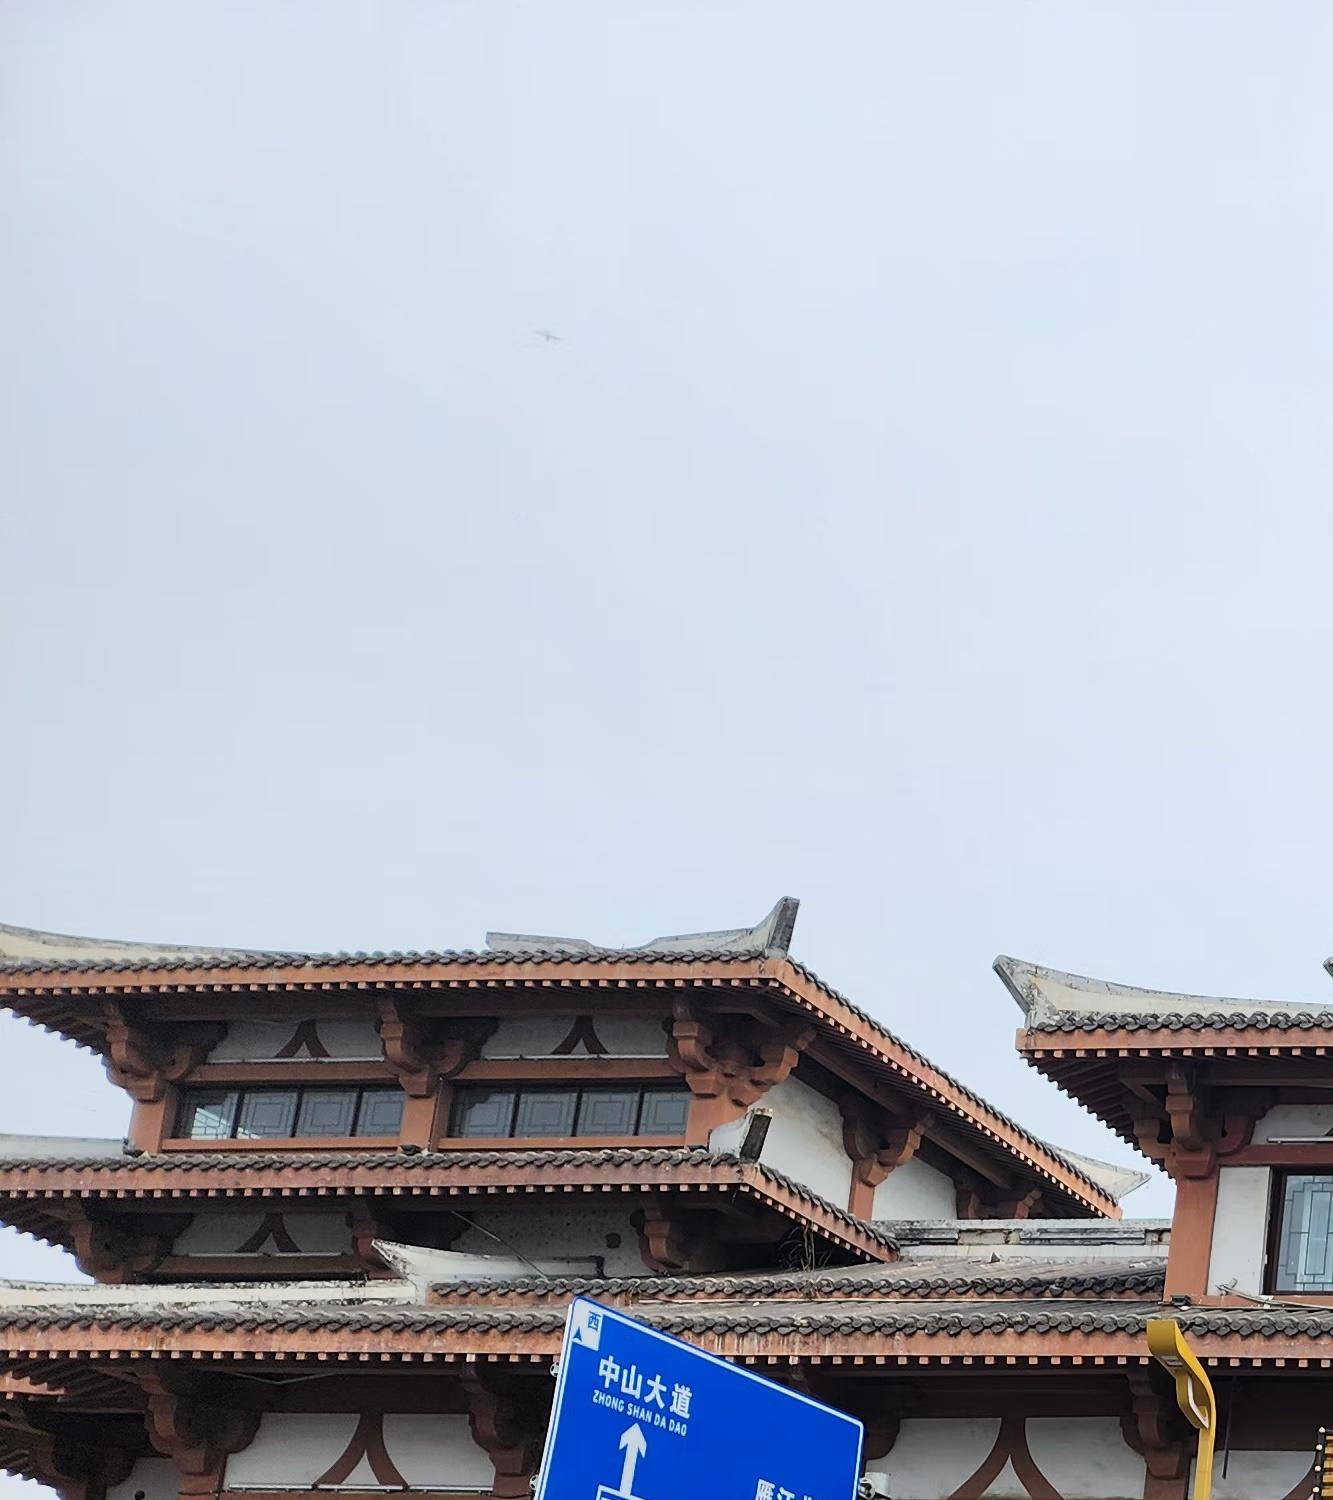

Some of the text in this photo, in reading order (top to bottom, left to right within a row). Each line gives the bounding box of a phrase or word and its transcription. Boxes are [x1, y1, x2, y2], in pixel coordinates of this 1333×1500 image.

[588, 1311, 601, 1331] 西
[598, 1355, 693, 1419] 中山大道
[592, 1389, 688, 1437] ZHONG SHAN DA DAO
